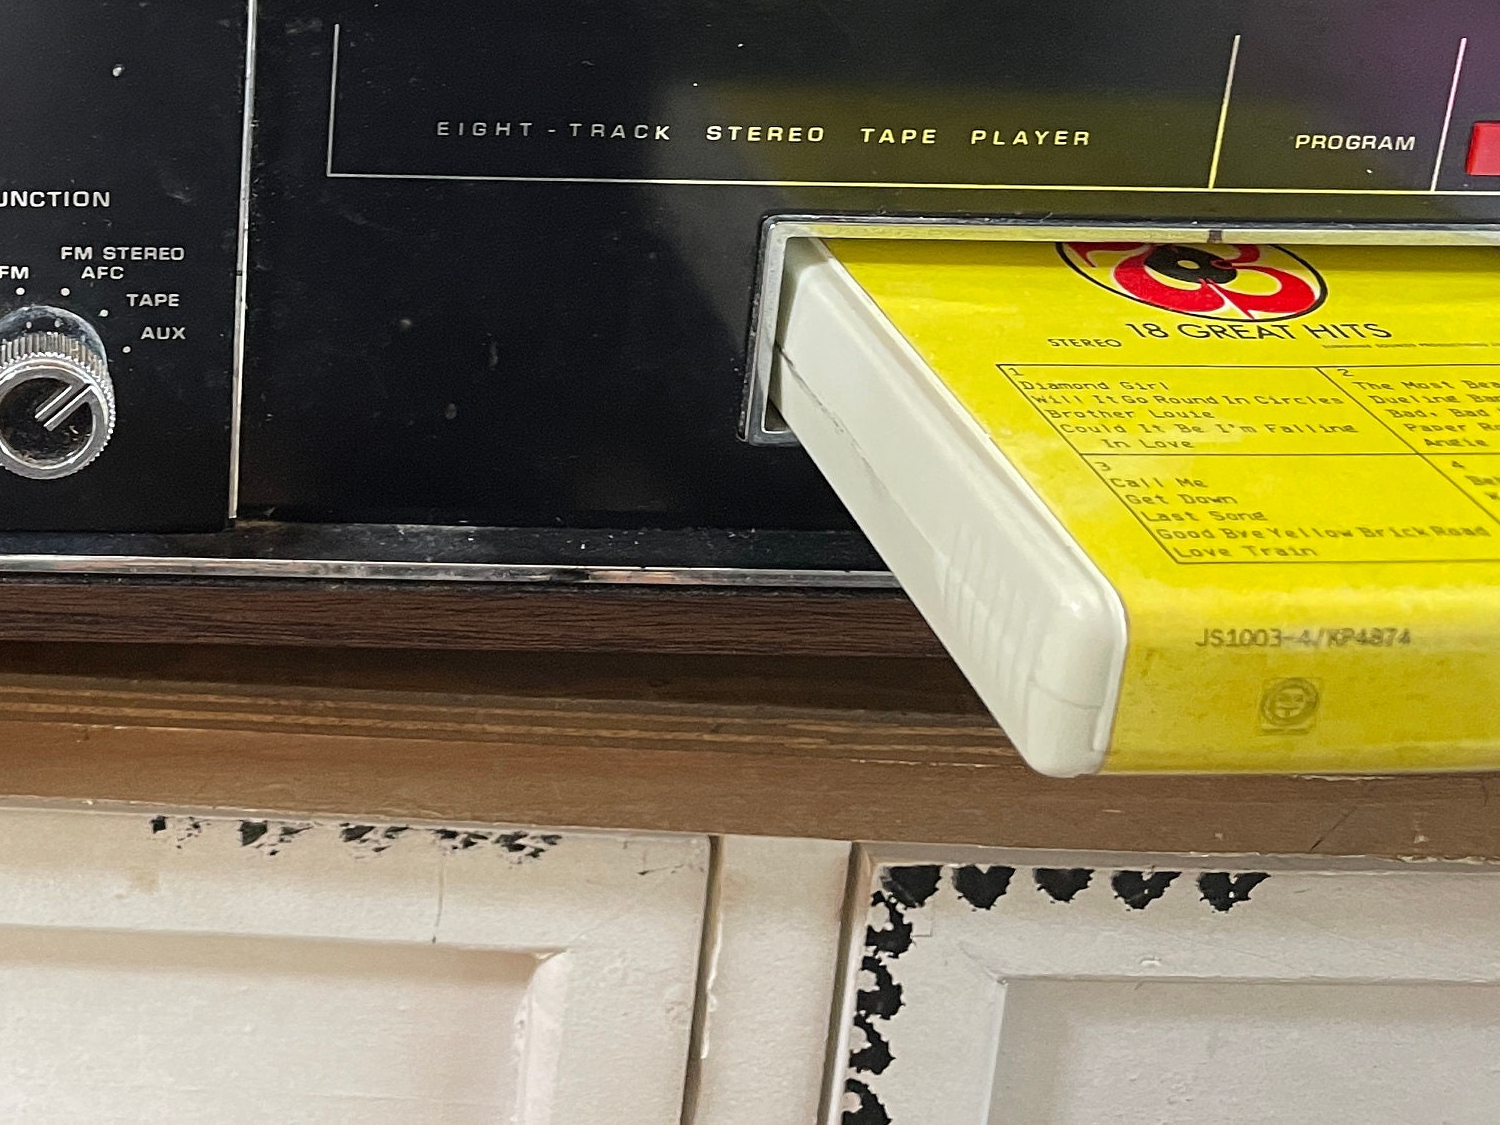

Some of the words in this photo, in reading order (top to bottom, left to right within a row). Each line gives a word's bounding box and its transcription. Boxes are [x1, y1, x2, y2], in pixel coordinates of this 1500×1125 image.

[706, 125, 824, 142] STEREO
[860, 128, 937, 144] TAPE
[970, 129, 1090, 146] PLAYER
[1295, 134, 1416, 151] PROGRAM
[61, 246, 93, 261] FM
[102, 246, 185, 261] STEREO
[80, 266, 124, 280] AFC
[125, 293, 180, 307] TAPE
[140, 326, 186, 340] AUX
[1125, 323, 1170, 339] 18
[1177, 323, 1297, 340] GREAT
[1302, 323, 1393, 339] HITS
[1047, 338, 1123, 348] STEREO
[1018, 380, 1111, 391] Diamond
[1119, 381, 1169, 391] Girl
[1351, 381, 1395, 391] The
[1400, 380, 1455, 390] Most
[1031, 395, 1083, 405] Will
[1093, 394, 1119, 404] It
[1120, 395, 1149, 404] Go
[1152, 395, 1220, 405] Round
[1221, 395, 1251, 405] In
[1253, 395, 1344, 405] Circles
[1367, 394, 1461, 404] Dueling
[1045, 409, 1135, 419] Brother
[1147, 409, 1216, 419] Louie
[1447, 408, 1491, 418] Bad
[1059, 423, 1127, 434] Could
[1137, 423, 1165, 434] It
[1173, 423, 1205, 434] Be
[1215, 423, 1258, 434] I'm
[1263, 423, 1359, 434] Falling
[1402, 423, 1466, 433] Paper
[1101, 438, 1131, 449] In
[1138, 438, 1195, 449] Love
[1109, 477, 1164, 488] Call
[1174, 477, 1208, 488] Me
[1125, 494, 1169, 505] Get
[1177, 493, 1238, 505] Down
[1141, 510, 1200, 522] Last
[1208, 510, 1269, 522] Song
[1156, 528, 1216, 540] Good
[1266, 527, 1354, 539] Yellow
[1173, 546, 1233, 558] Love
[1241, 545, 1318, 557] Train
